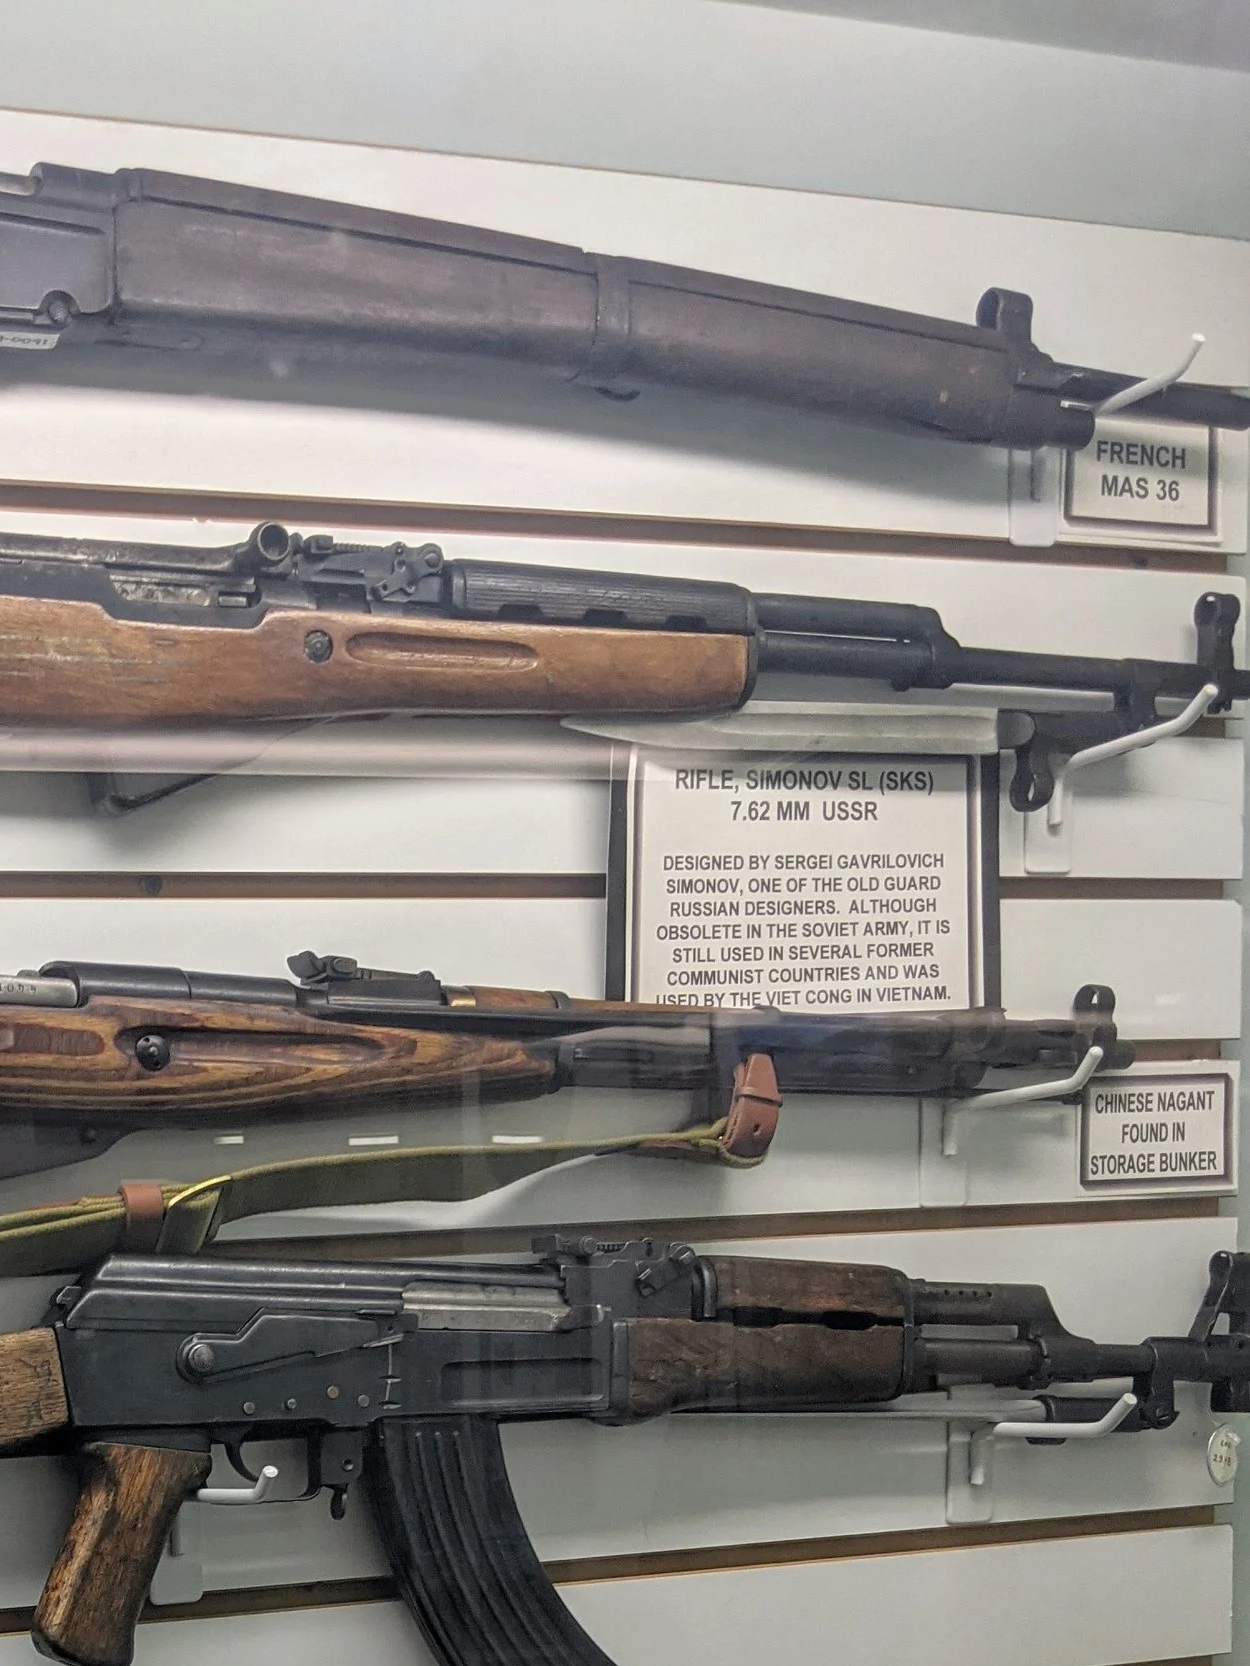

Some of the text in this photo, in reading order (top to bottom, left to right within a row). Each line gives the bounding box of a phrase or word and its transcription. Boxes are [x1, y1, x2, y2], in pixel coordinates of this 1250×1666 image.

[1096, 440, 1186, 469] FRENCH
[1101, 474, 1180, 502] MAS 36
[675, 769, 934, 795] RIFLE, SIMONOV SL (SKS)
[731, 800, 878, 821] 7.62 MM USSR
[663, 853, 944, 871] DESIGNED BY SERGEI GAVRILOVICH
[666, 876, 941, 896] SIMONOV, ONE OF THE OLD GUARD
[670, 898, 936, 917] RUSSIAN DESIGNERS. ALTHOUGH
[656, 919, 950, 941] OBSOLETE IN THE SOVIET ARMY, IT IS
[672, 942, 934, 963] STILL USED IN SEVERAL FORMER
[667, 964, 939, 986] COMMUNIST COUNTRIES AND WAS
[704, 993, 725, 1007] BY
[730, 992, 761, 1006] THE
[766, 990, 801, 1006] VIET
[805, 988, 852, 1004] CONG
[857, 988, 872, 1003] IN
[876, 985, 951, 1002] VIETNAM.
[1095, 1090, 1215, 1114] CHINESE NAGANT
[1121, 1121, 1185, 1144] FOUND IN
[1090, 1151, 1217, 1175] STORAGE BUNKER
